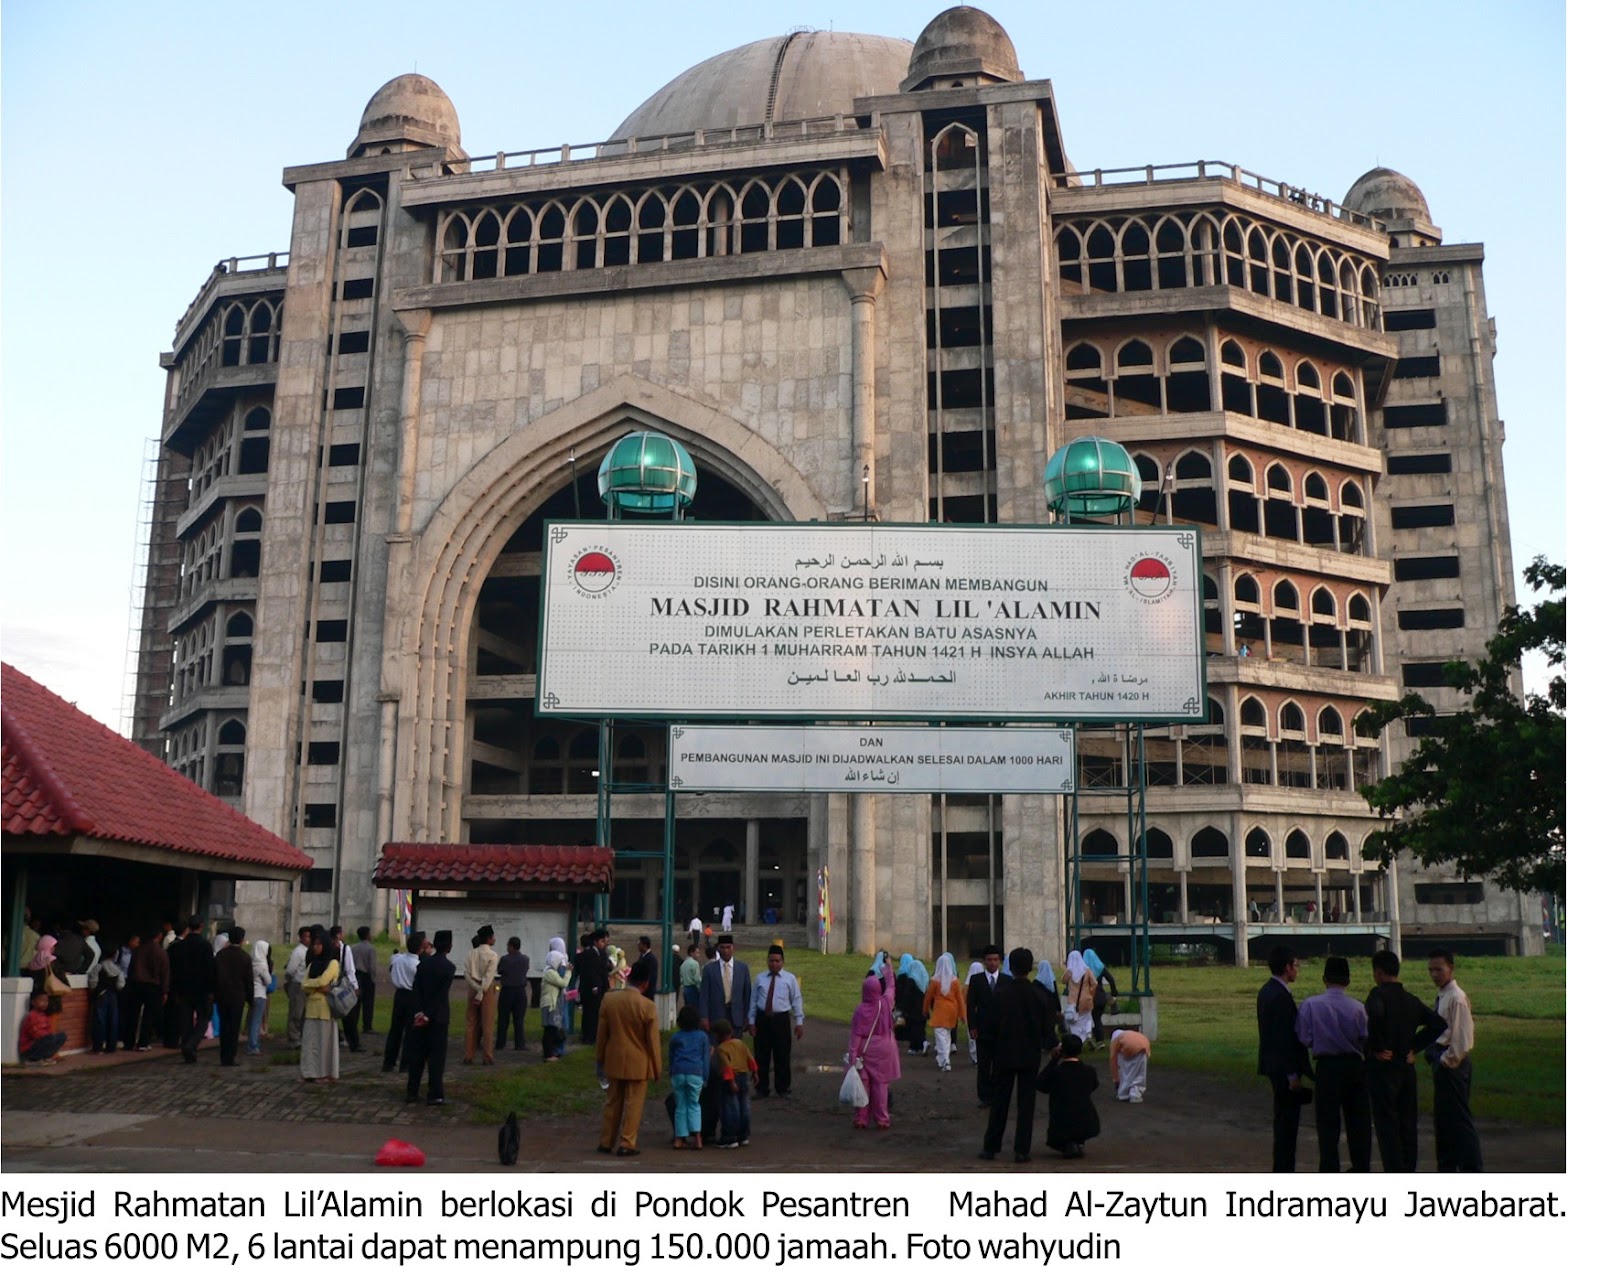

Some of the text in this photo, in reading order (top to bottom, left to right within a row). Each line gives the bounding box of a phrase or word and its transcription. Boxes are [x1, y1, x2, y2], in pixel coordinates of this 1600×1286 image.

[567, 544, 623, 581] YAYASAN PESANTREN
[795, 552, 944, 571] بسم الله الرحمن الرحيم
[694, 576, 1048, 592] DISINI ORANG-ORANG BERIMAN MEMBANGUN
[572, 586, 617, 600] INDONESIA
[650, 597, 1101, 619] MASJID RAHMATAN LIL 'ALAMIN
[705, 625, 1038, 640] DIMULAKAN PERLETAKAN BATU ASASNYA
[649, 643, 1094, 660] PADA TARIKH 1 MUHARRAM TAHUN 1421 H INSYA ALLAH
[866, 674, 890, 687] رب
[1043, 691, 1150, 701] AKHIR TAHUN 1420 H
[859, 737, 884, 748] DAN
[680, 752, 1063, 766] PEMBANGUNAN MASJID INI DIJADWALKAN SELESAI DALAM 1000 HARI
[844, 766, 861, 782] الله
